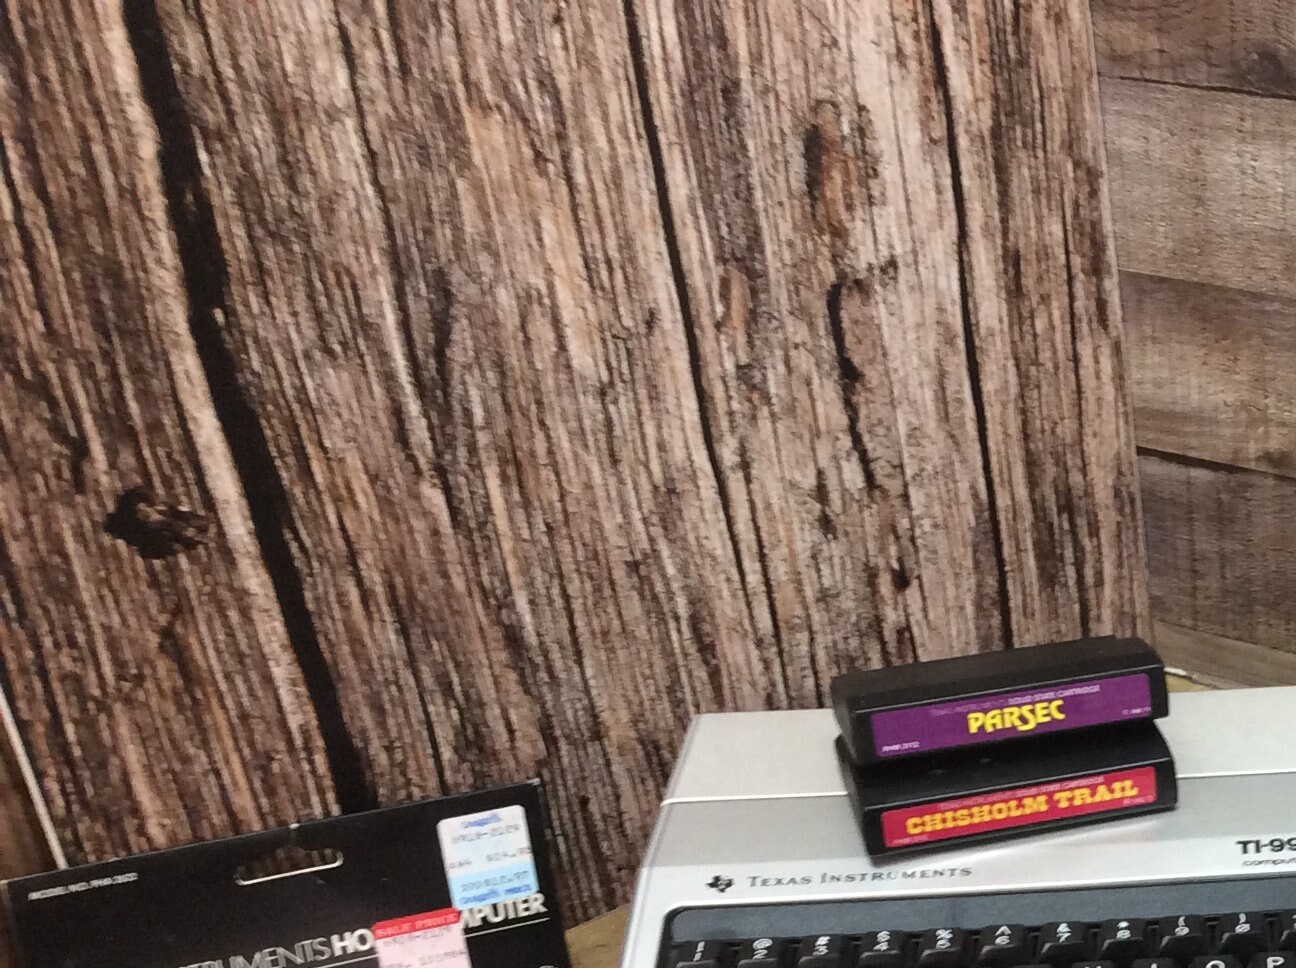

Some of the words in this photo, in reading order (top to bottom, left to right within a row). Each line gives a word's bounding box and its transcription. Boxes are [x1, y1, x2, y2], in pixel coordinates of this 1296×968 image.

[966, 699, 1067, 735] PARSEC
[905, 795, 1049, 835] CHISHOLM
[1053, 779, 1139, 809] TRAIL
[748, 874, 812, 888] TEXAS
[820, 867, 973, 885] INSTRUMENTS
[461, 893, 549, 929] MPUTER
